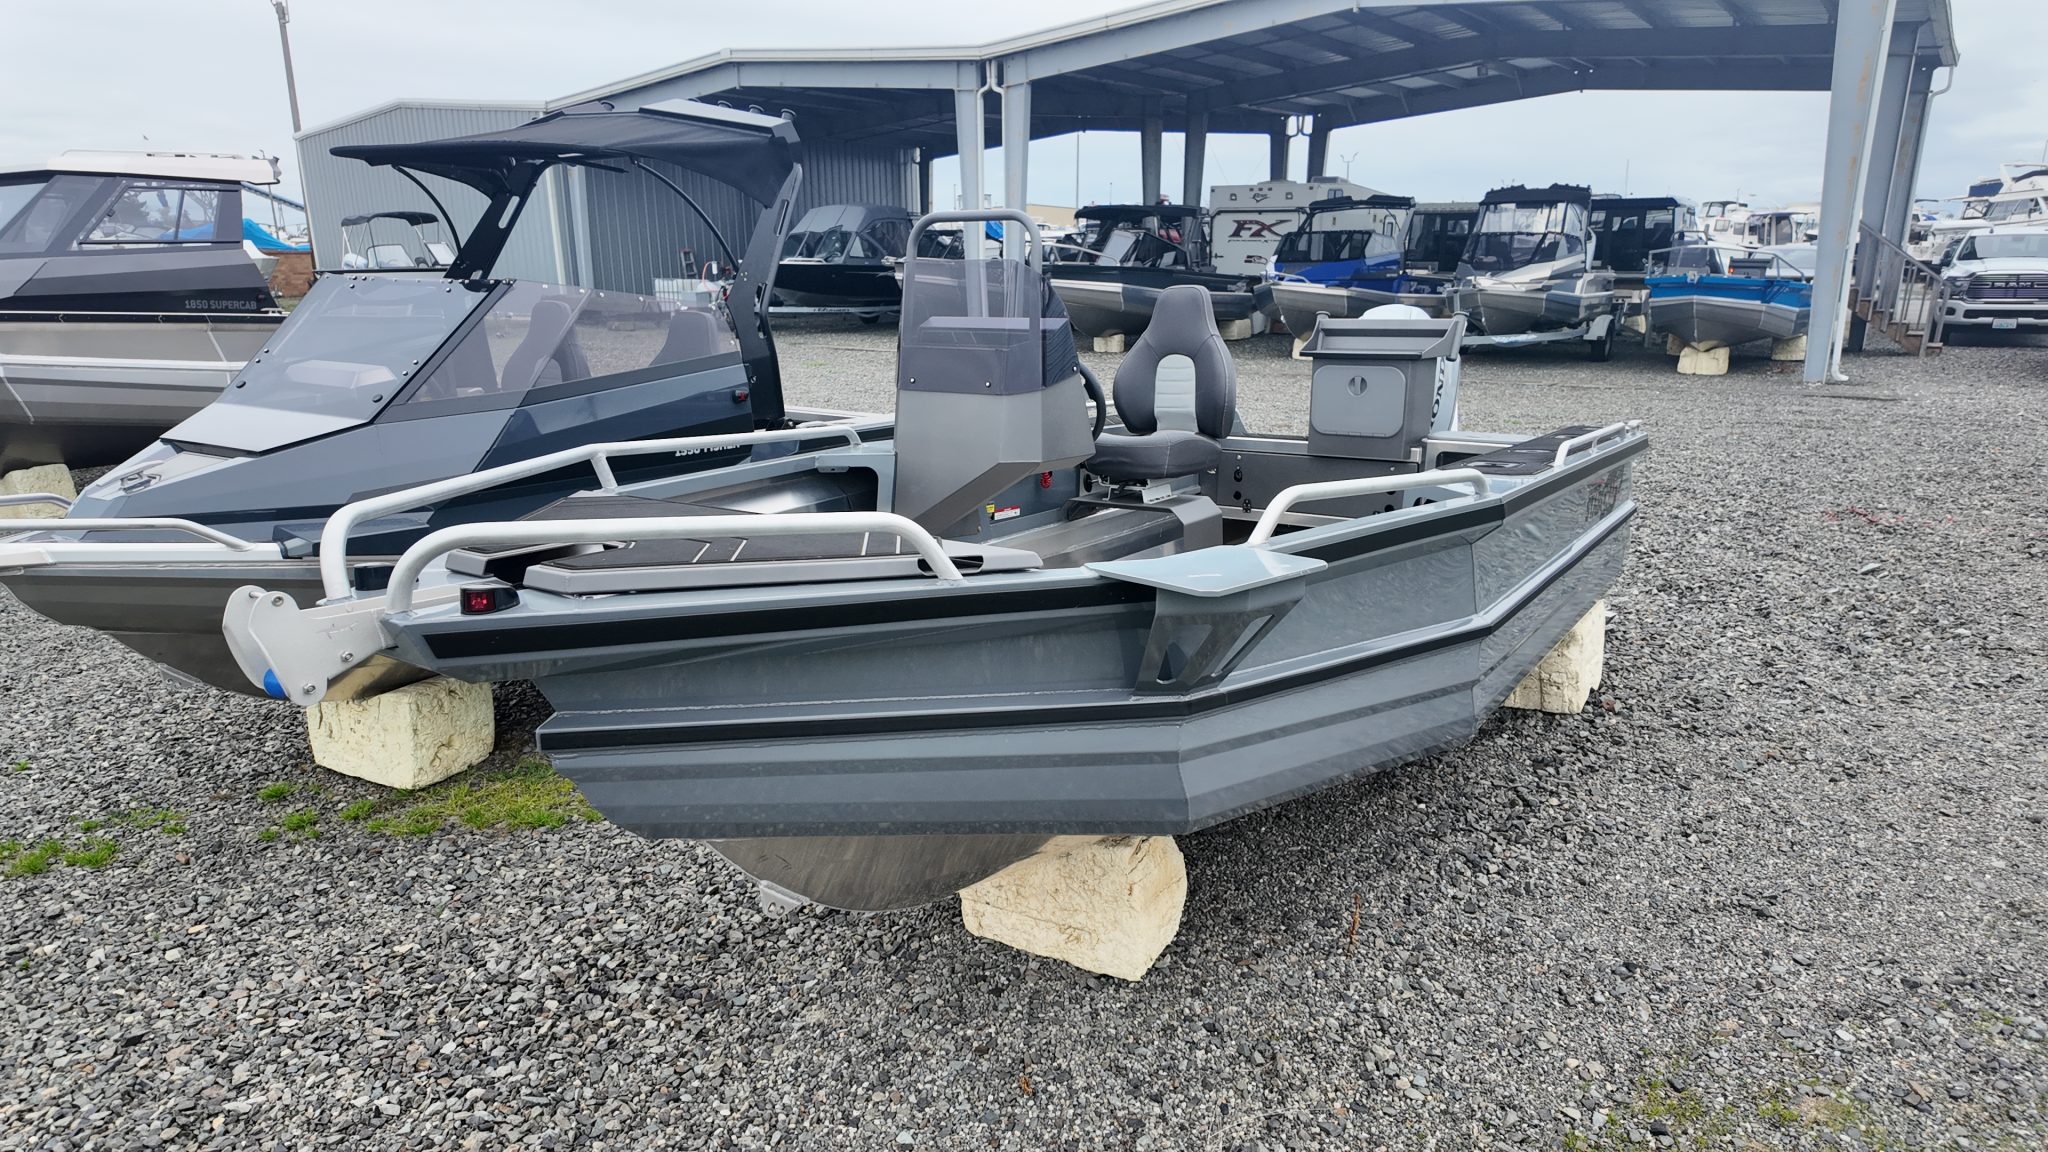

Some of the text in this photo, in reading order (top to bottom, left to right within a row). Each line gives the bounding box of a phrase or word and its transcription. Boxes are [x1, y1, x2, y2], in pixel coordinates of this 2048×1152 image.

[1228, 220, 1292, 238] FX
[185, 300, 257, 310] 1850 SUPERCAB
[1430, 356, 1444, 430] OND
